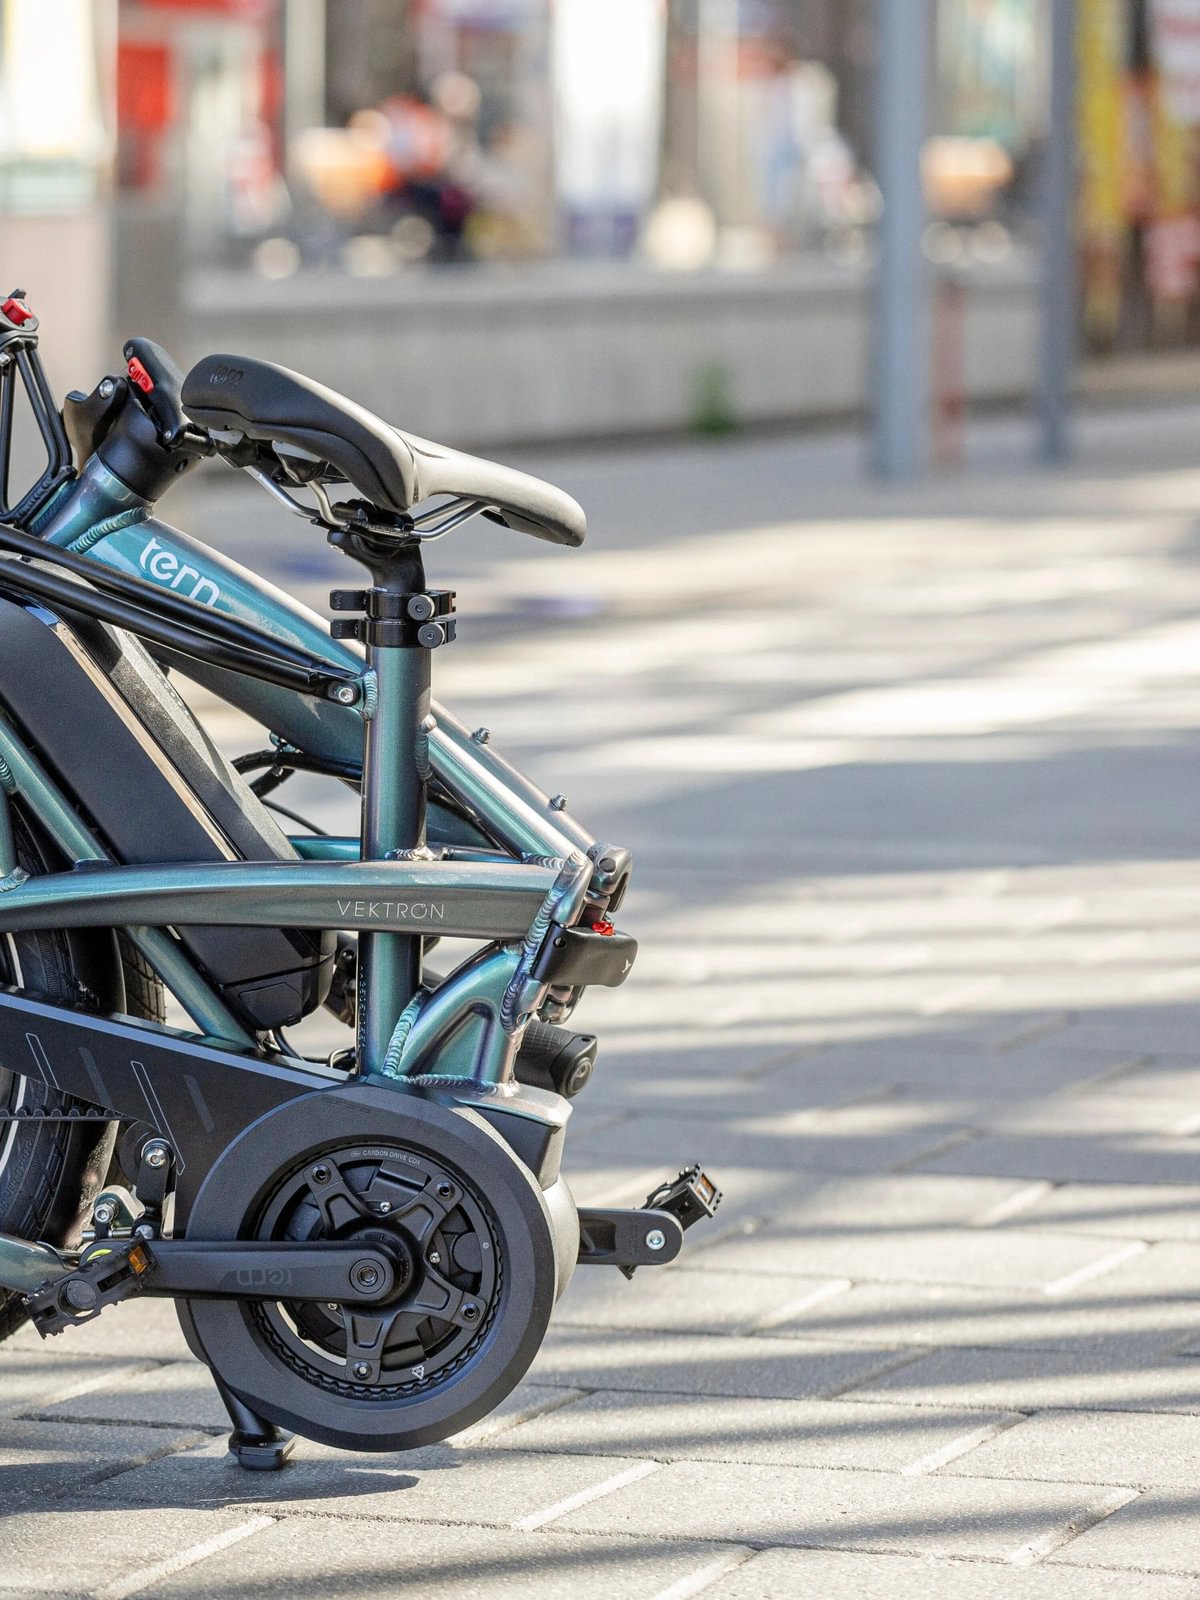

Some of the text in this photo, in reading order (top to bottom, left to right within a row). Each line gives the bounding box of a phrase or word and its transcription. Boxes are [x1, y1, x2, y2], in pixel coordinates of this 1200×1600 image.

[139, 537, 220, 607] tern
[336, 900, 445, 920] VEKTRON
[362, 1149, 389, 1157] CARBON
[389, 1151, 408, 1161] DRIVE
[236, 1268, 293, 1287] tern
